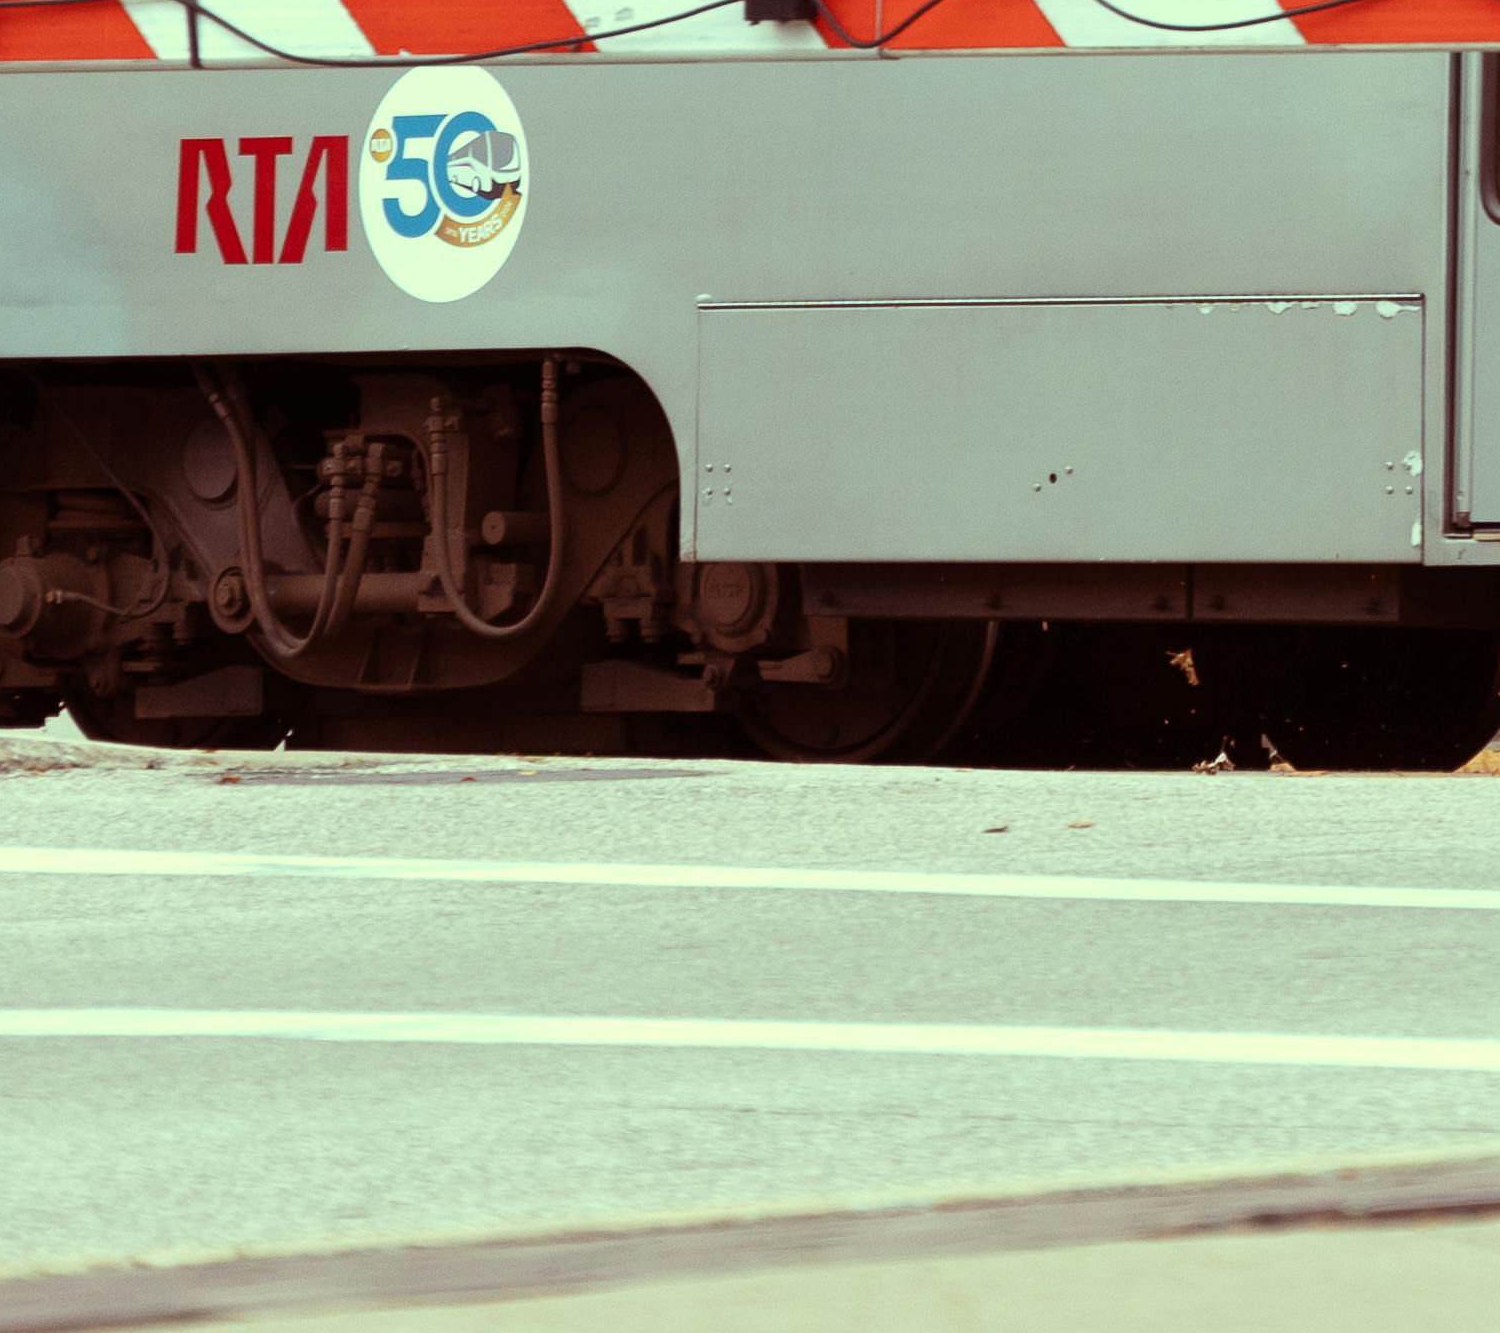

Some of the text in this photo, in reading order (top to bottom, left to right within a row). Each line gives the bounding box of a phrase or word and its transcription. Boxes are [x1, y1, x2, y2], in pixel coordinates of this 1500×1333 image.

[175, 135, 349, 265] RTA
[382, 110, 498, 239] 50
[458, 214, 504, 243] YEARS
